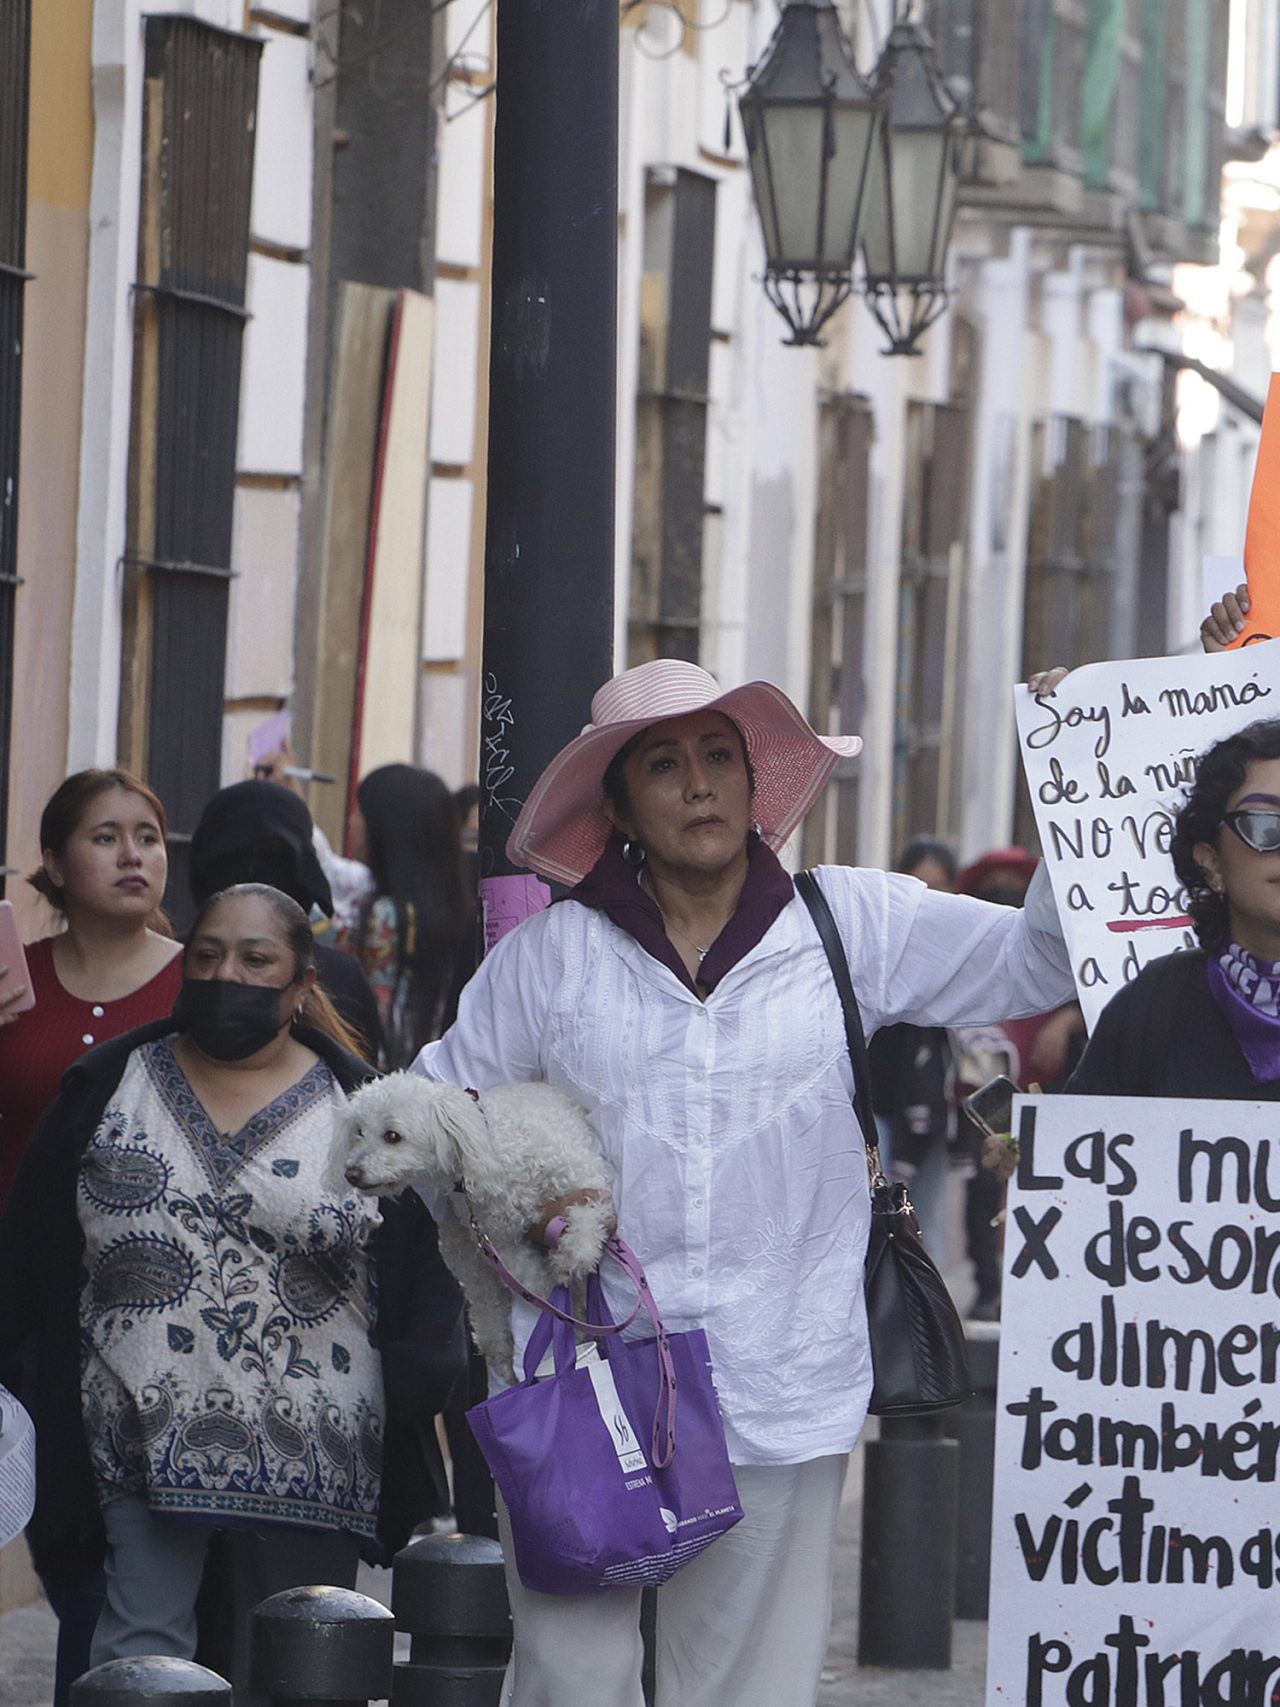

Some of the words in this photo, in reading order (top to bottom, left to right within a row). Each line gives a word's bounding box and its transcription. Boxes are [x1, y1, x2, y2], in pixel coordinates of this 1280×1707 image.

[1026, 688, 1112, 758] Soy
[1121, 683, 1152, 717] la
[1159, 673, 1272, 717] mamá
[1039, 758, 1089, 804] de
[1097, 761, 1137, 798] la
[1145, 748, 1200, 792] niñ
[1066, 882, 1096, 912] a
[1015, 1105, 1138, 1196] Las
